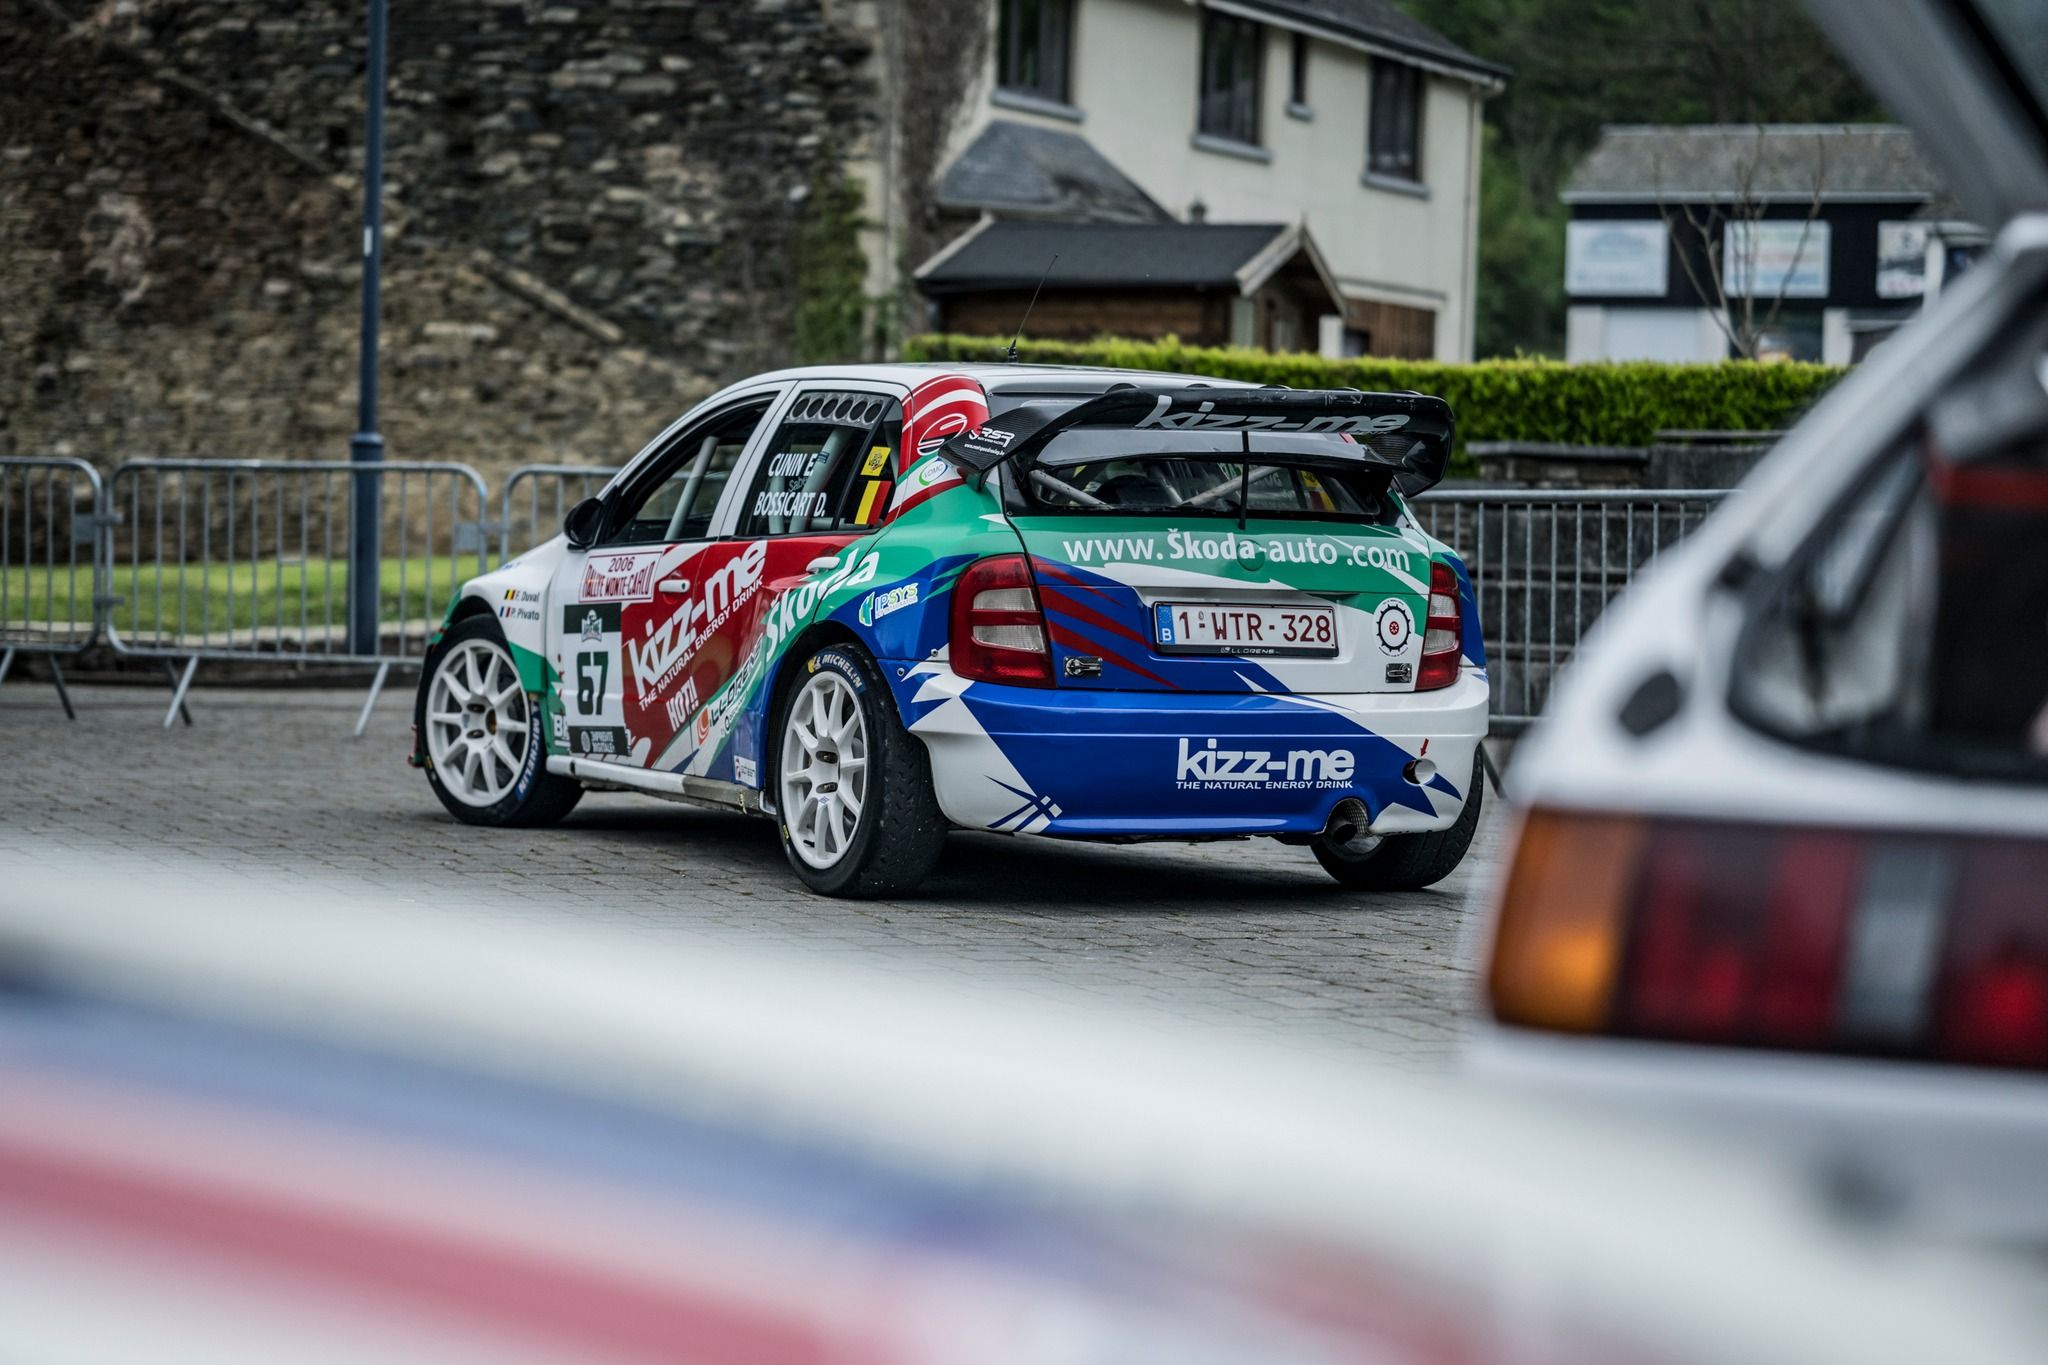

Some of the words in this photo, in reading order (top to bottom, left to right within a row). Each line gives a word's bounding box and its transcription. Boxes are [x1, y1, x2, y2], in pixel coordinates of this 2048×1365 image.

[1135, 394, 1411, 433] kizz-me
[768, 453, 807, 477] CUNIN
[753, 491, 817, 517] BOSSICART
[813, 492, 827, 517] D.
[582, 564, 606, 598] RALLYE
[606, 560, 655, 597] MONTE-CARLO
[608, 556, 636, 573] 2006
[521, 591, 540, 601] Duval
[766, 548, 880, 662] Škoda
[875, 583, 918, 613] IPSYS
[511, 608, 517, 618] P.
[517, 609, 540, 621] Pivato
[628, 540, 768, 701] kizz-me
[638, 691, 658, 712] THE
[658, 649, 695, 695] NATURAL
[694, 608, 731, 650] ENERGY
[732, 575, 764, 613] DRINK
[1161, 628, 1172, 642] B
[576, 651, 609, 716] 67
[821, 654, 863, 689] MICHELIN
[518, 717, 541, 795] MICHELIN
[1176, 737, 1356, 781] kizz-me
[1176, 781, 1201, 790] THE
[1204, 781, 1262, 790] NATURAL
[1265, 780, 1314, 790] ENERGY
[1315, 780, 1353, 789] DRINK
